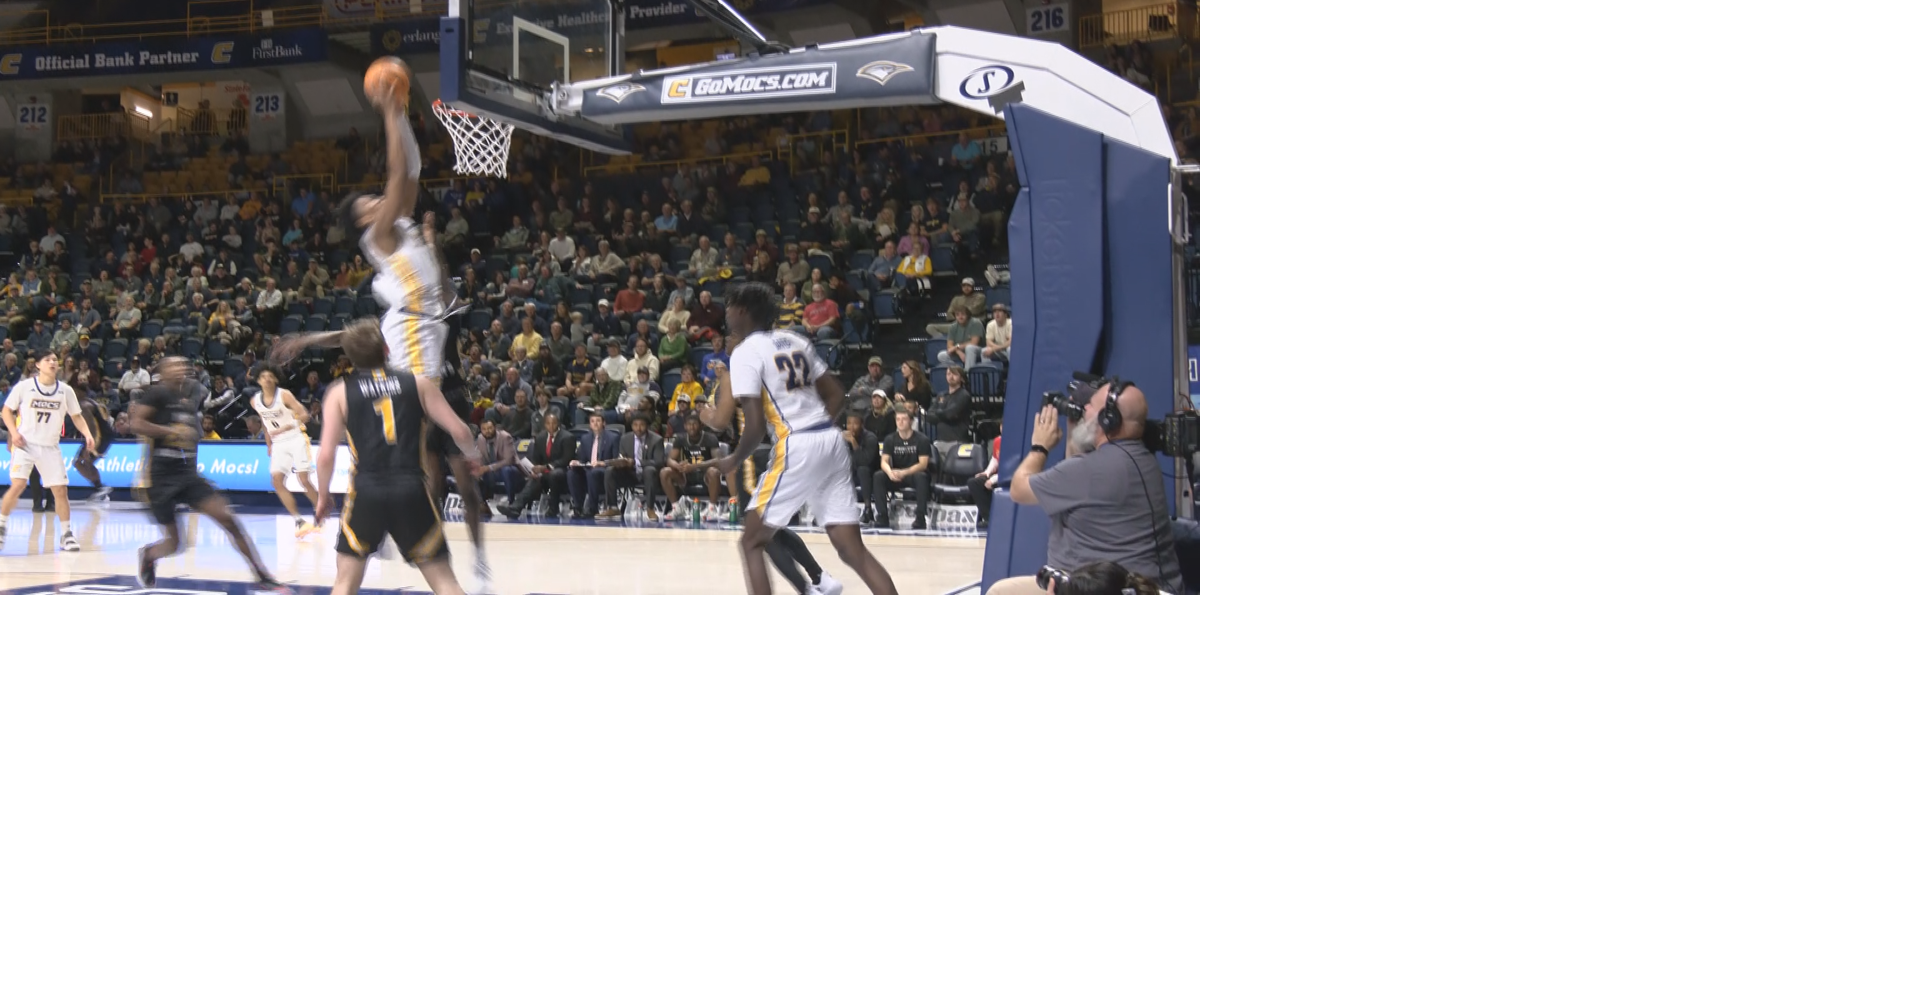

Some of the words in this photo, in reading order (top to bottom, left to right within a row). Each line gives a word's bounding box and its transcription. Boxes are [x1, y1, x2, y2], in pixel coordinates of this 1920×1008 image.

[630, 2, 687, 19] Provider
[1031, 7, 1064, 32] 216
[35, 54, 90, 71] Official
[95, 52, 134, 67] Bank
[139, 48, 199, 66] Partner
[252, 44, 302, 59] FirstBank
[255, 95, 279, 113] 213
[20, 107, 47, 123] 212
[774, 350, 811, 392] 22
[37, 411, 51, 423] 77
[372, 395, 397, 445] 1
[210, 458, 259, 474] Mocs!
